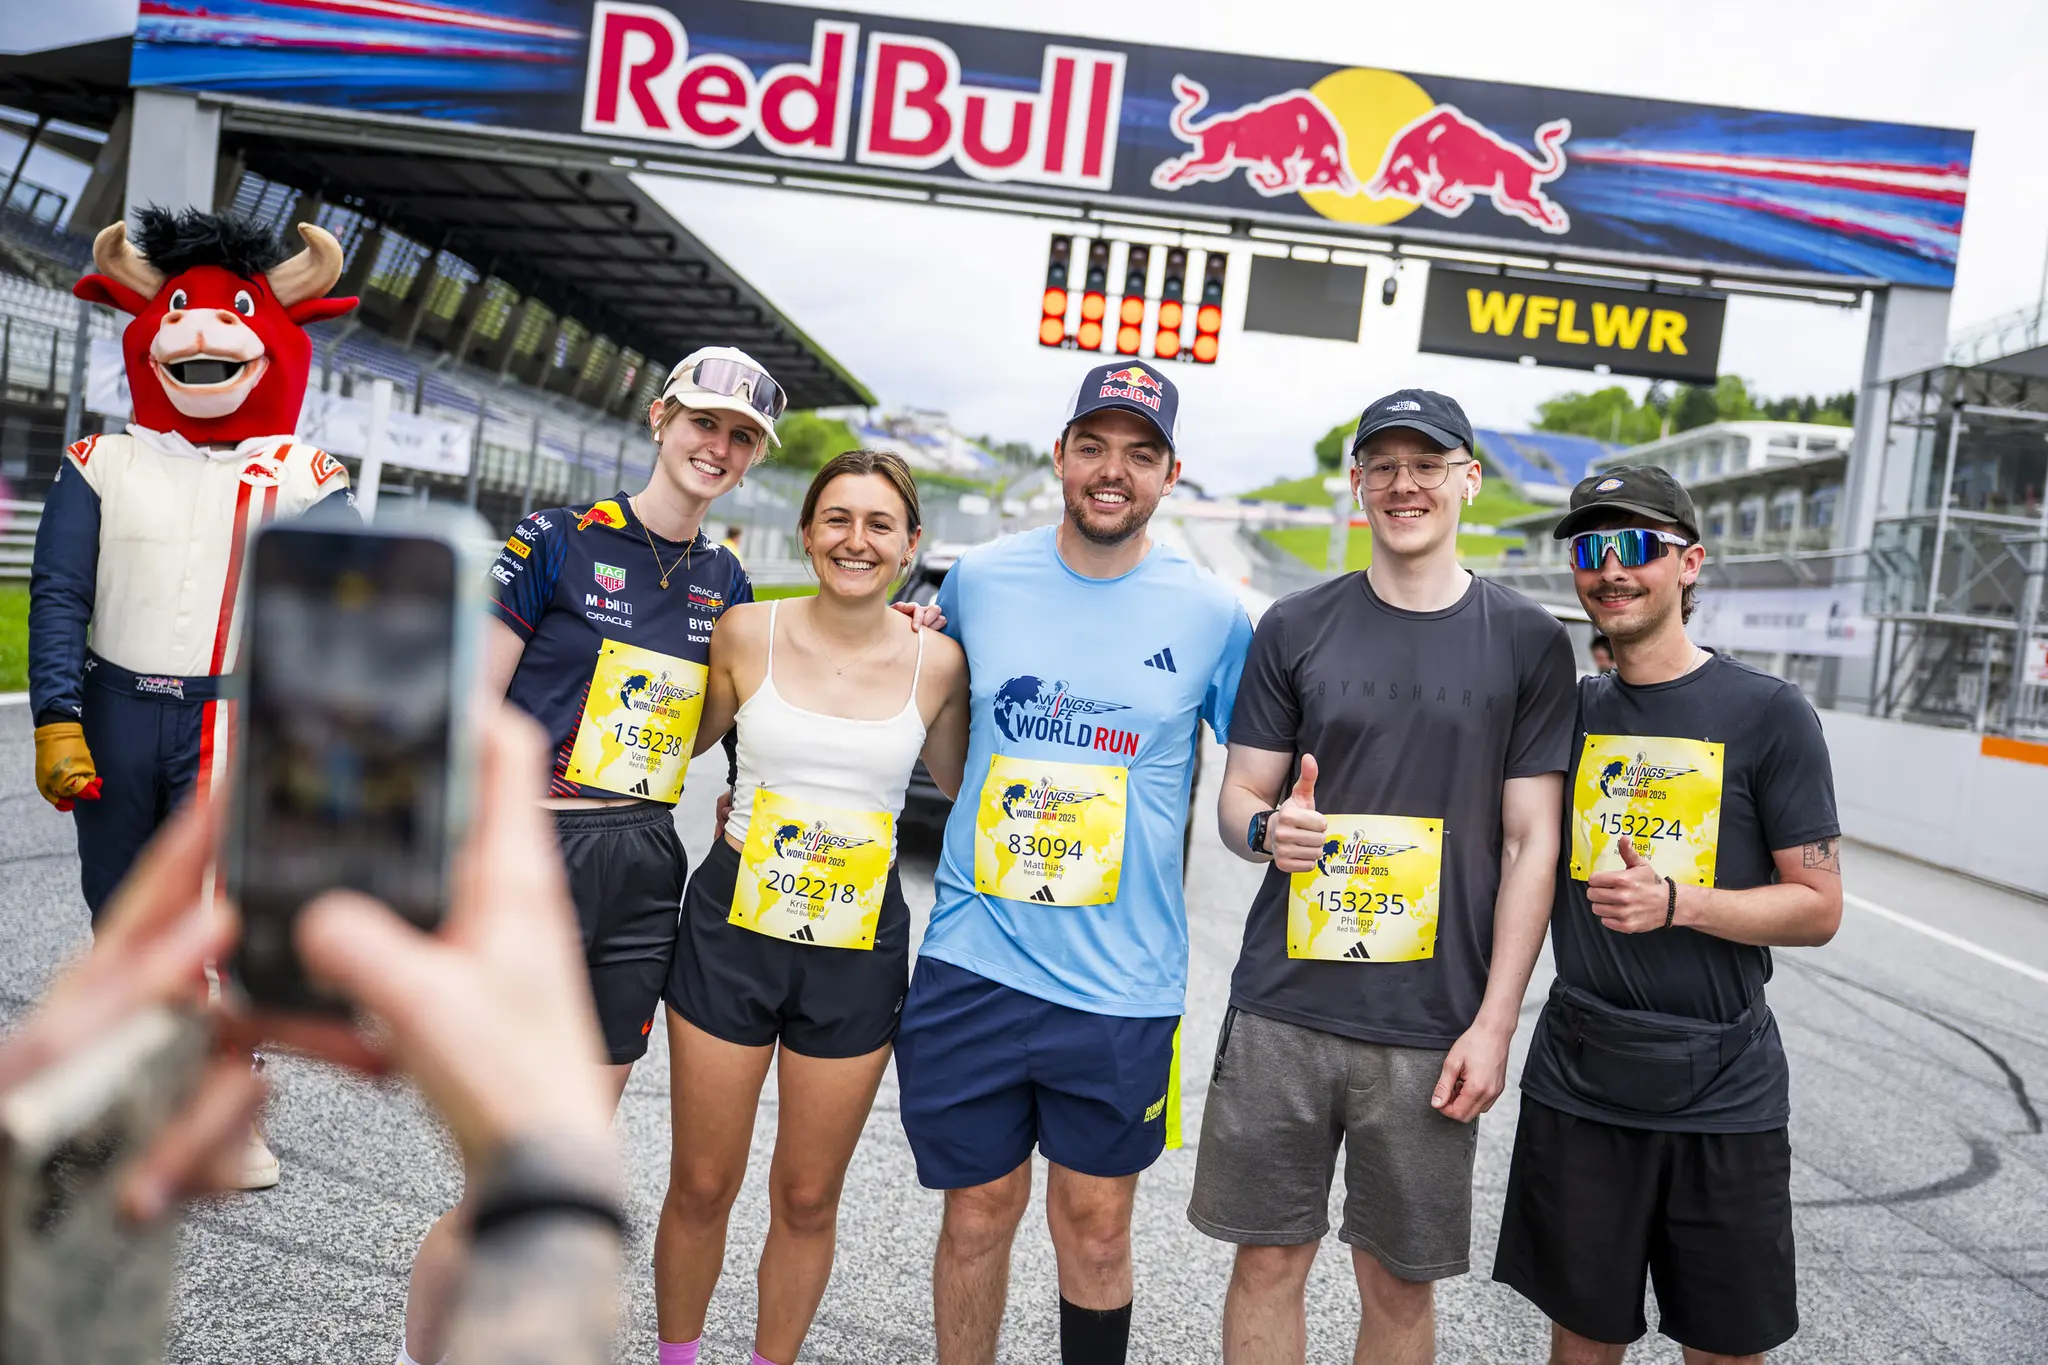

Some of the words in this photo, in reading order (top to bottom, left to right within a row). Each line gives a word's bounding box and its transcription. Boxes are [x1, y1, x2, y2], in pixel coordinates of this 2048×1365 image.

[585, 2, 855, 156] Red
[862, 38, 1120, 186] Bull
[1467, 288, 1689, 356] WFLWR
[1099, 385, 1131, 399] Red
[1132, 387, 1161, 412] Bull
[597, 565, 623, 579] TAG
[595, 574, 624, 592] HEUER
[689, 584, 722, 599] ORACLE
[585, 593, 620, 612] Mobil
[586, 611, 632, 628] ORACLE
[687, 634, 711, 643] HON
[649, 682, 685, 699] WINGS
[1318, 680, 1495, 712] GYMSHARK
[650, 694, 673, 706] LIFE
[1038, 692, 1095, 712] WINGS
[668, 709, 681, 719] 2025
[1044, 706, 1074, 721] LIFE
[614, 723, 682, 757] 153238
[1015, 713, 1092, 748] WORLD
[1093, 727, 1140, 757] RUN
[631, 751, 662, 766] Vanessa
[628, 760, 639, 769] Red
[639, 763, 649, 771] Bull
[650, 765, 660, 774] Ring
[1625, 764, 1666, 778] WINGS
[1628, 777, 1652, 788] LIFE
[1029, 787, 1075, 803] WINGS
[1649, 789, 1667, 800] 2025
[1034, 800, 1062, 812] LIFE
[1058, 812, 1077, 823] 2025
[1600, 812, 1683, 841] 153224
[802, 830, 847, 847] WINGS
[1617, 840, 1651, 851] hael
[805, 843, 832, 855] LIFE
[1008, 833, 1083, 861] 83094
[1342, 843, 1387, 856] WINGS
[828, 857, 846, 867] 2025
[1023, 859, 1064, 872] Matthias
[1346, 855, 1373, 865] LIFE
[1023, 869, 1037, 877] Red
[1037, 870, 1048, 878] Bull
[1049, 871, 1063, 880] Ring
[1370, 867, 1389, 876] 2025
[765, 870, 855, 904] 202218
[789, 899, 825, 912] Kristina
[1317, 890, 1404, 915] 153235
[799, 909, 811, 917] Bull
[812, 911, 825, 921] Ring
[1340, 916, 1374, 928] Philipp
[1362, 927, 1377, 936] Ring
